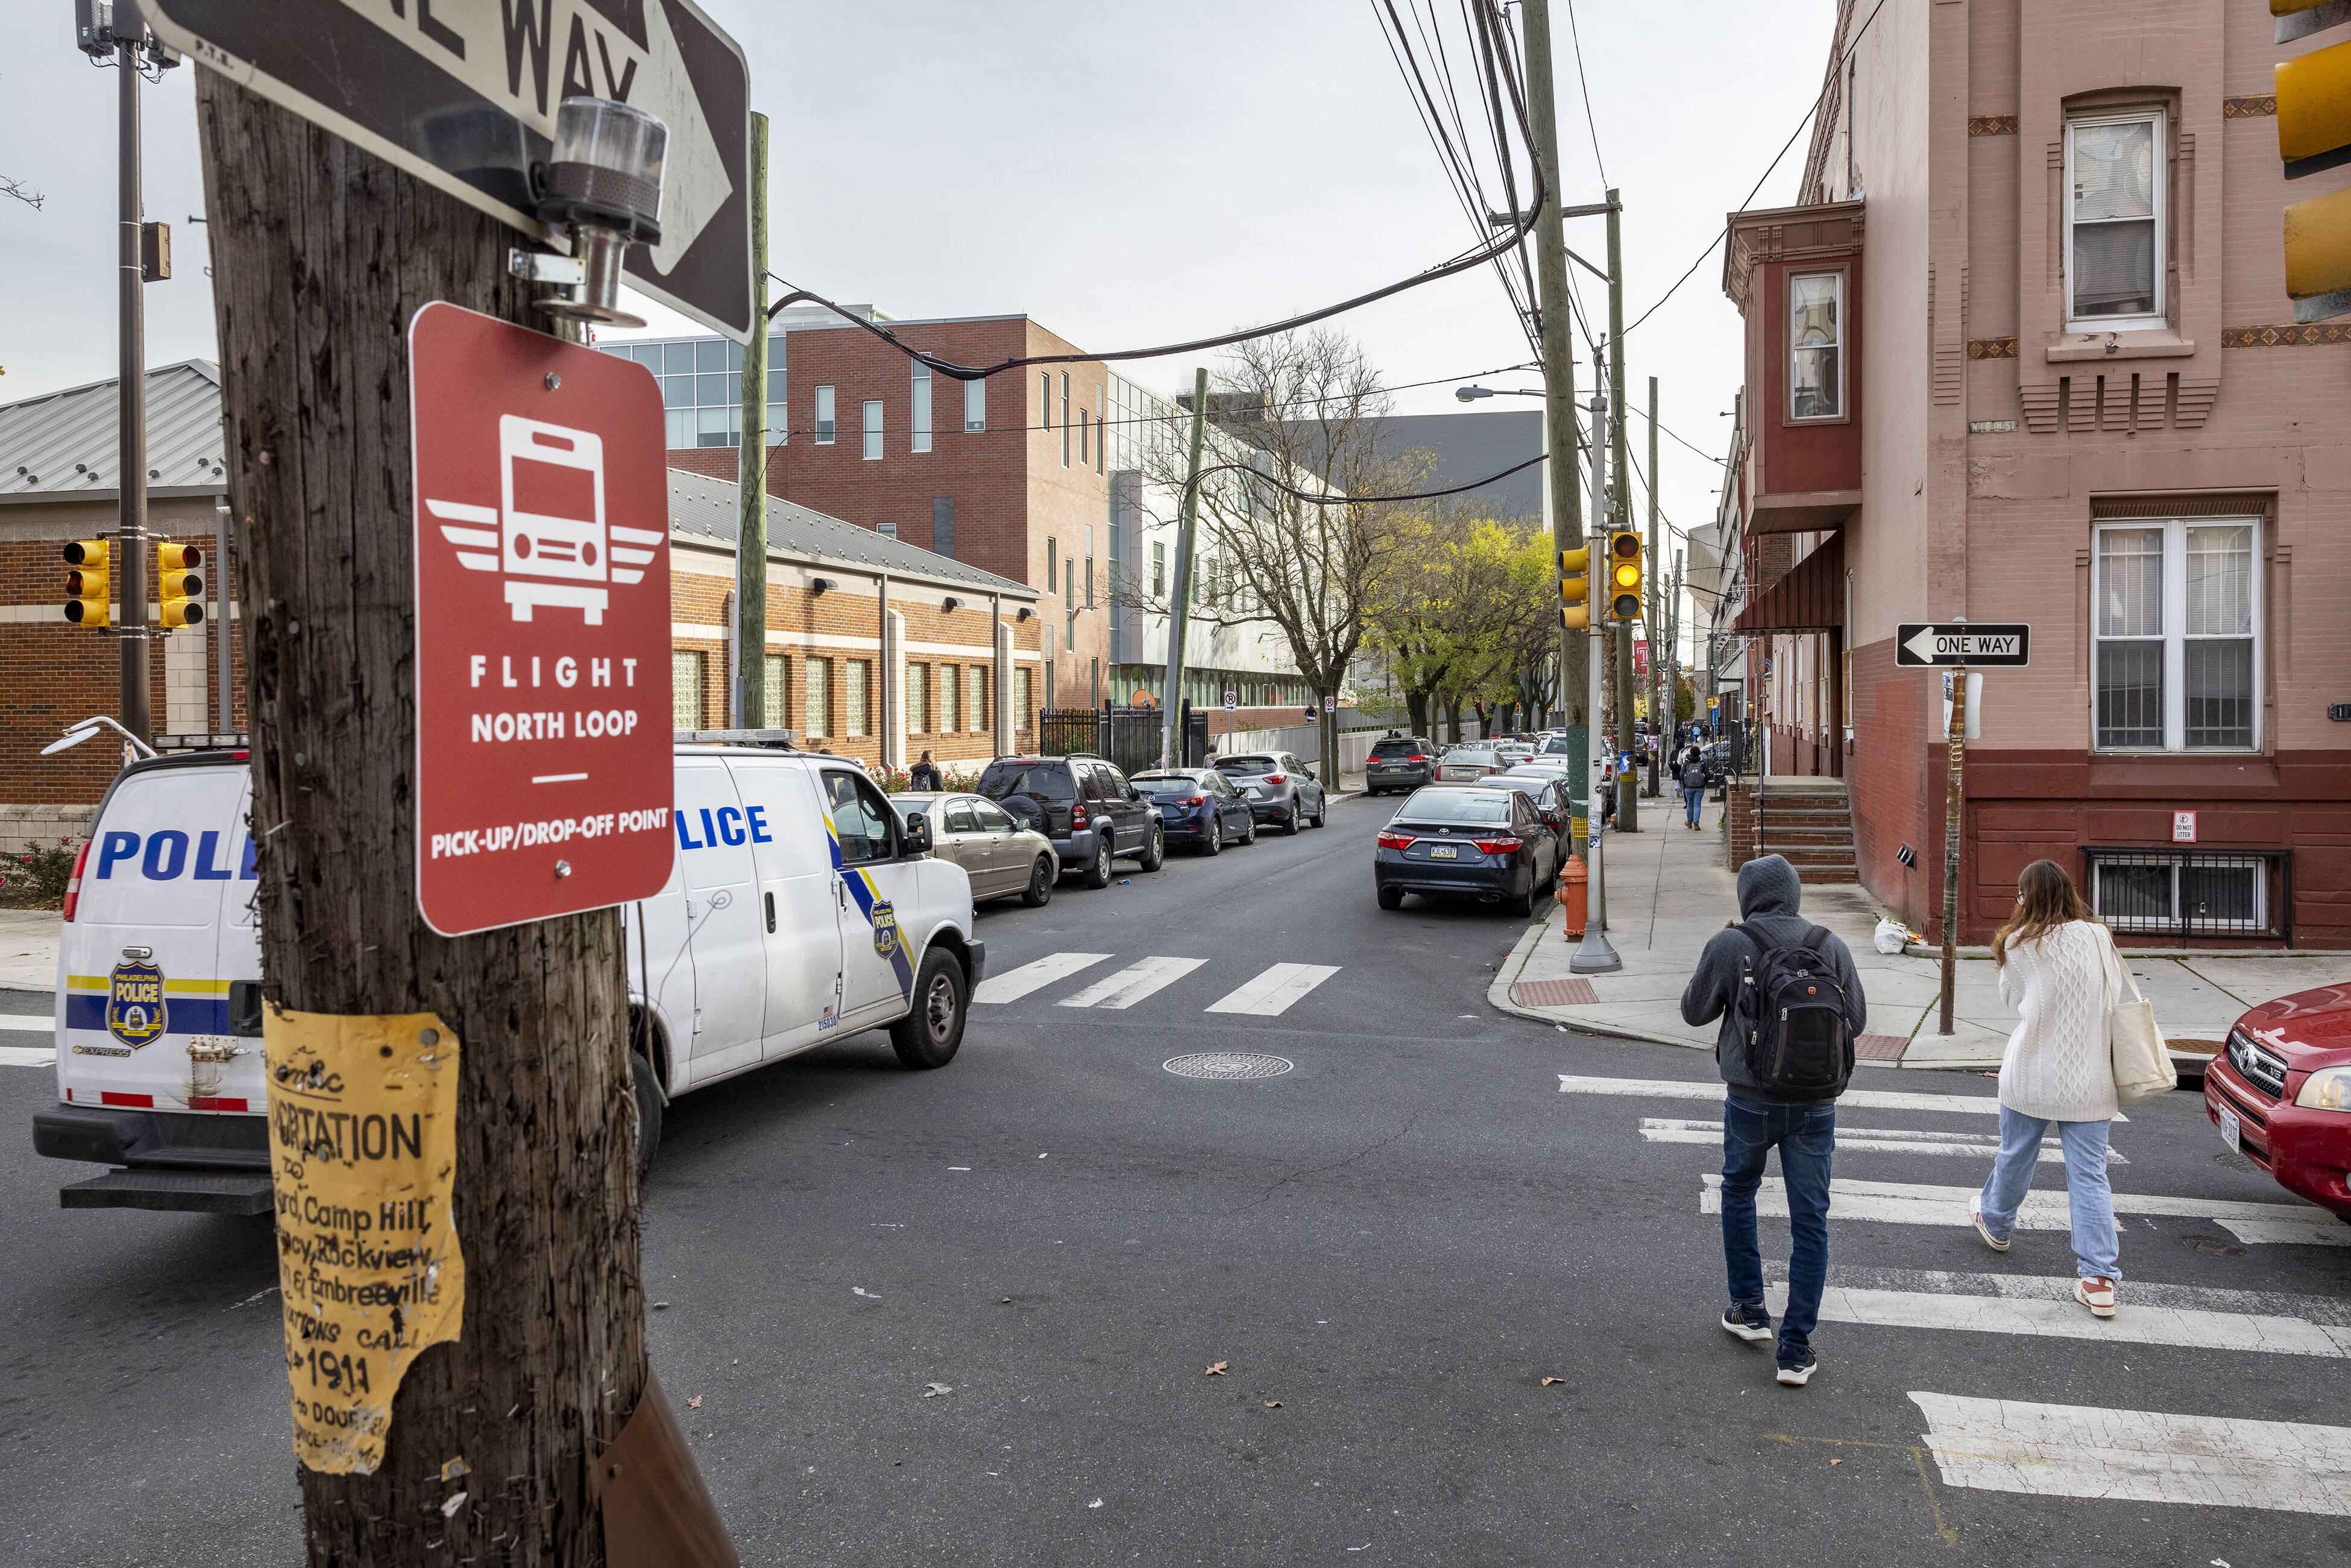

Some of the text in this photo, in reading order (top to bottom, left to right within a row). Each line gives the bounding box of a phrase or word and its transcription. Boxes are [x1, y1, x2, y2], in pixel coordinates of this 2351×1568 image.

[1936, 637, 2015, 653] ONE WAY
[470, 655, 637, 687] FLIGHT
[471, 710, 638, 743] NORTH LOOP
[431, 807, 669, 859] PICK-UP/DROP-OFF POINT
[675, 805, 773, 851] LICE
[96, 830, 258, 881] POLI
[875, 914, 895, 929] POLICE
[116, 983, 159, 1003] POLICE
[818, 1016, 837, 1031] 215030
[82, 1047, 131, 1057] EXPRESS
[2270, 1067, 2282, 1079] V6
[304, 1196, 372, 1239] Camp
